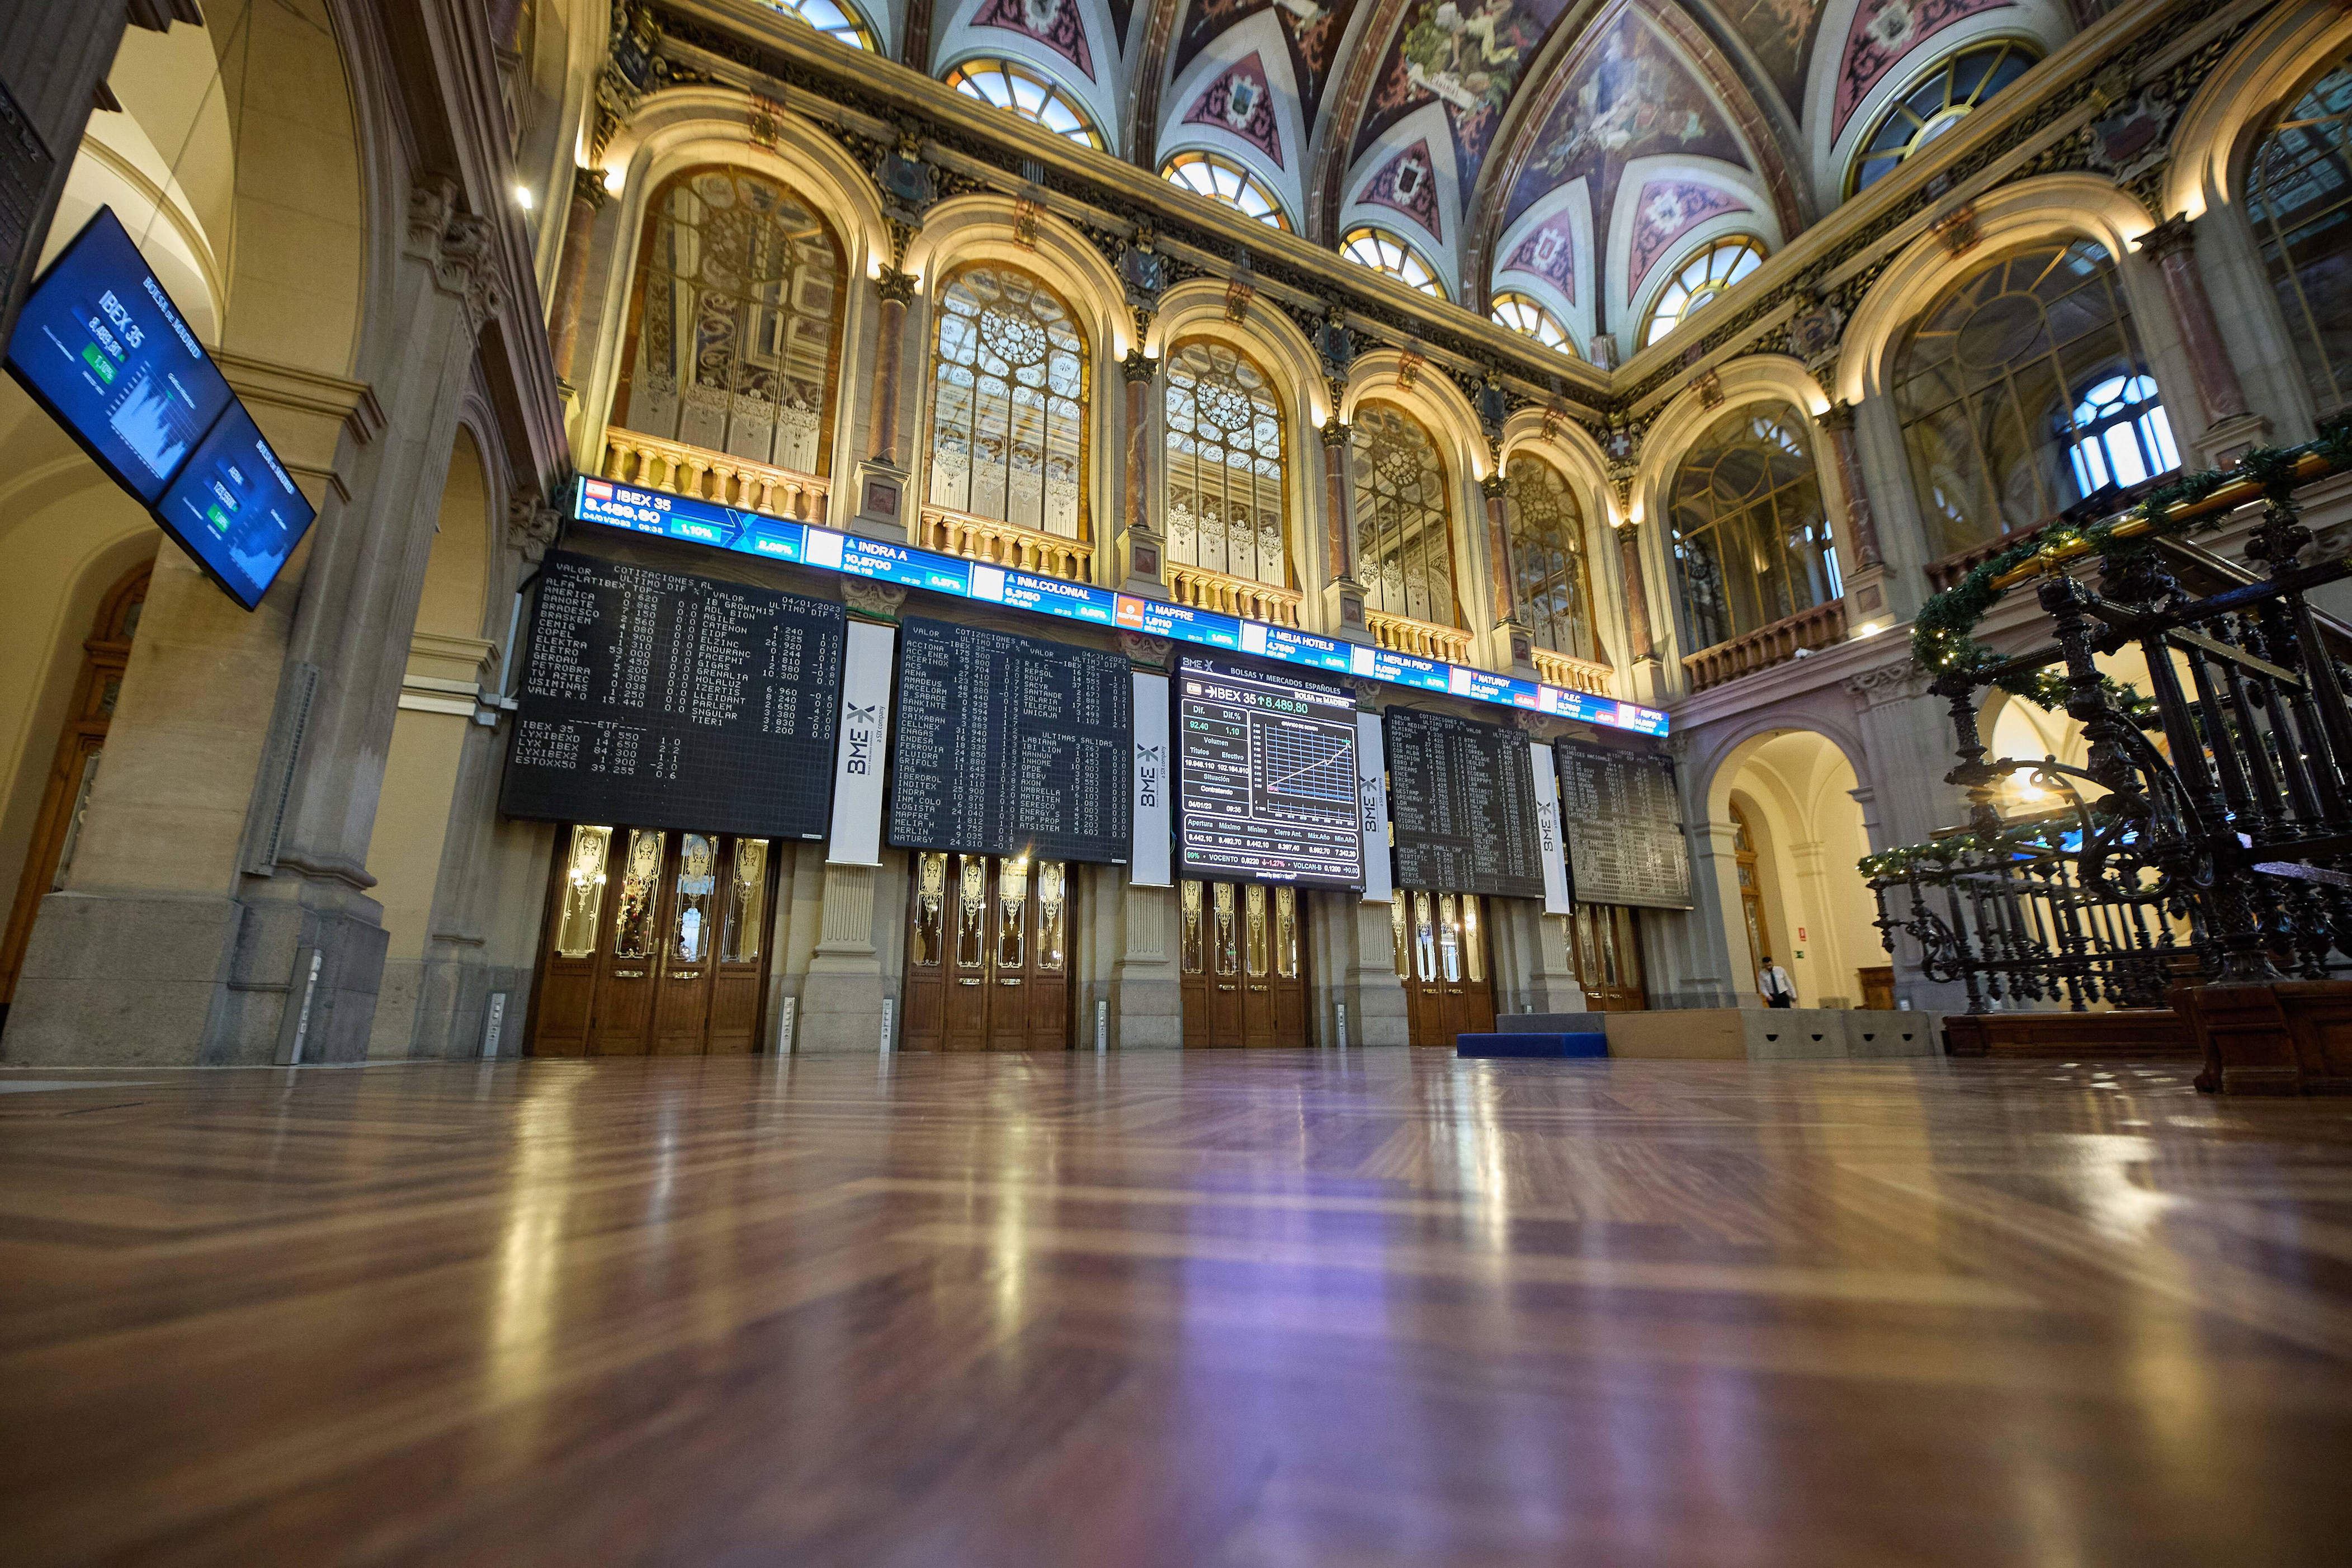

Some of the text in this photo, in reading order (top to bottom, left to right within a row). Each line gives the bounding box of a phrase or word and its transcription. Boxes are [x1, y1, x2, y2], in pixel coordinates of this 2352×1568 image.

[98, 287, 145, 351] IBEX 35
[615, 489, 672, 512] IBEX 35
[582, 511, 631, 527] 04/01/2023
[680, 523, 713, 540] 1,10%
[858, 540, 908, 561] INDRA A
[545, 577, 576, 589] ALFA
[555, 562, 592, 576] VALOR
[619, 574, 660, 588] ULTIMO
[667, 582, 687, 593] DIF
[543, 585, 596, 601] AMERICA
[613, 565, 841, 613] COTIZACIONES AL 04/01/2023
[1017, 575, 1090, 600] INM.COLONIAL
[542, 593, 594, 609] BANORTE
[706, 598, 774, 616] IB GROWTH15
[712, 591, 744, 603] VALOR
[768, 601, 805, 615] ULTIMO
[811, 608, 828, 618] DIF
[541, 601, 600, 618] BRADESCO
[703, 604, 755, 620] ADL BION
[1155, 604, 1194, 622] MAPFRE
[702, 612, 735, 625] AGILE
[701, 620, 748, 634] CATENON
[535, 635, 588, 650] ELEKTRA
[913, 627, 1010, 650] VALOR ULTIMO DIF
[955, 627, 1016, 644] COTIZACIONES
[1276, 630, 1301, 644] MELIA
[1302, 636, 1334, 652] HOTELS
[906, 640, 944, 653] ACCIONA
[530, 660, 591, 676] PETROBRA
[697, 659, 730, 672] GIGAS
[905, 654, 948, 667] ACERINOX
[1182, 656, 1202, 669] BME
[1383, 654, 1434, 672] MERLIN PROP.
[1024, 667, 1054, 678] REPSOL
[1230, 665, 1257, 678] BOLSAS
[1266, 673, 1302, 688] MERCADOS
[1305, 680, 1340, 695] ESPAÑOLES
[527, 677, 589, 692] USIMINAS
[904, 676, 942, 688] AMADEUS
[1478, 673, 1510, 688] NATURGY
[694, 683, 740, 697] IZERTIS
[1023, 687, 1062, 700] SANTANDE
[1294, 691, 1315, 702] BOLSA
[693, 691, 746, 705] LLEIDANT
[902, 697, 946, 710] BANKINTE
[1215, 686, 1308, 716] IBEX 35 8.489,80
[691, 707, 738, 720] SNGULAR
[1023, 701, 1062, 713] TELEFONI
[1023, 708, 1057, 719] UNICAJA
[1193, 705, 1240, 721] Dif. Dif.%
[690, 715, 724, 726] TIER1
[877, 706, 886, 729] company
[901, 712, 946, 724] CAIXABAN
[1189, 720, 1239, 737] 92,40 1,10
[1042, 731, 1113, 748] ULTIMAS SALIDAS
[1203, 736, 1228, 747] Volumen
[847, 728, 868, 774] BME
[899, 742, 944, 754] FERROVIA
[1222, 751, 1244, 761] Efectivo
[896, 779, 937, 790] INDITEX
[897, 772, 942, 783] IBERDROL
[1203, 772, 1230, 783] Situación
[1141, 767, 1155, 807] BME
[1200, 785, 1233, 796] Contratando
[895, 802, 935, 813] LOGISTA
[1188, 800, 1241, 814] 04/01/23 09:35
[1363, 796, 1377, 832] BME
[1019, 821, 1060, 832] ATSISTEM
[1187, 818, 1213, 829] Apertura
[1218, 821, 1240, 831] Máximo
[1274, 828, 1291, 837] Cierre
[1291, 830, 1302, 838] Ant.
[893, 833, 933, 844] NATURGY
[1541, 819, 1553, 852] BME
[1187, 851, 1199, 859] 99%
[1208, 853, 1238, 863] VOCENTO
[1293, 861, 1322, 871] VOLCAN-B
